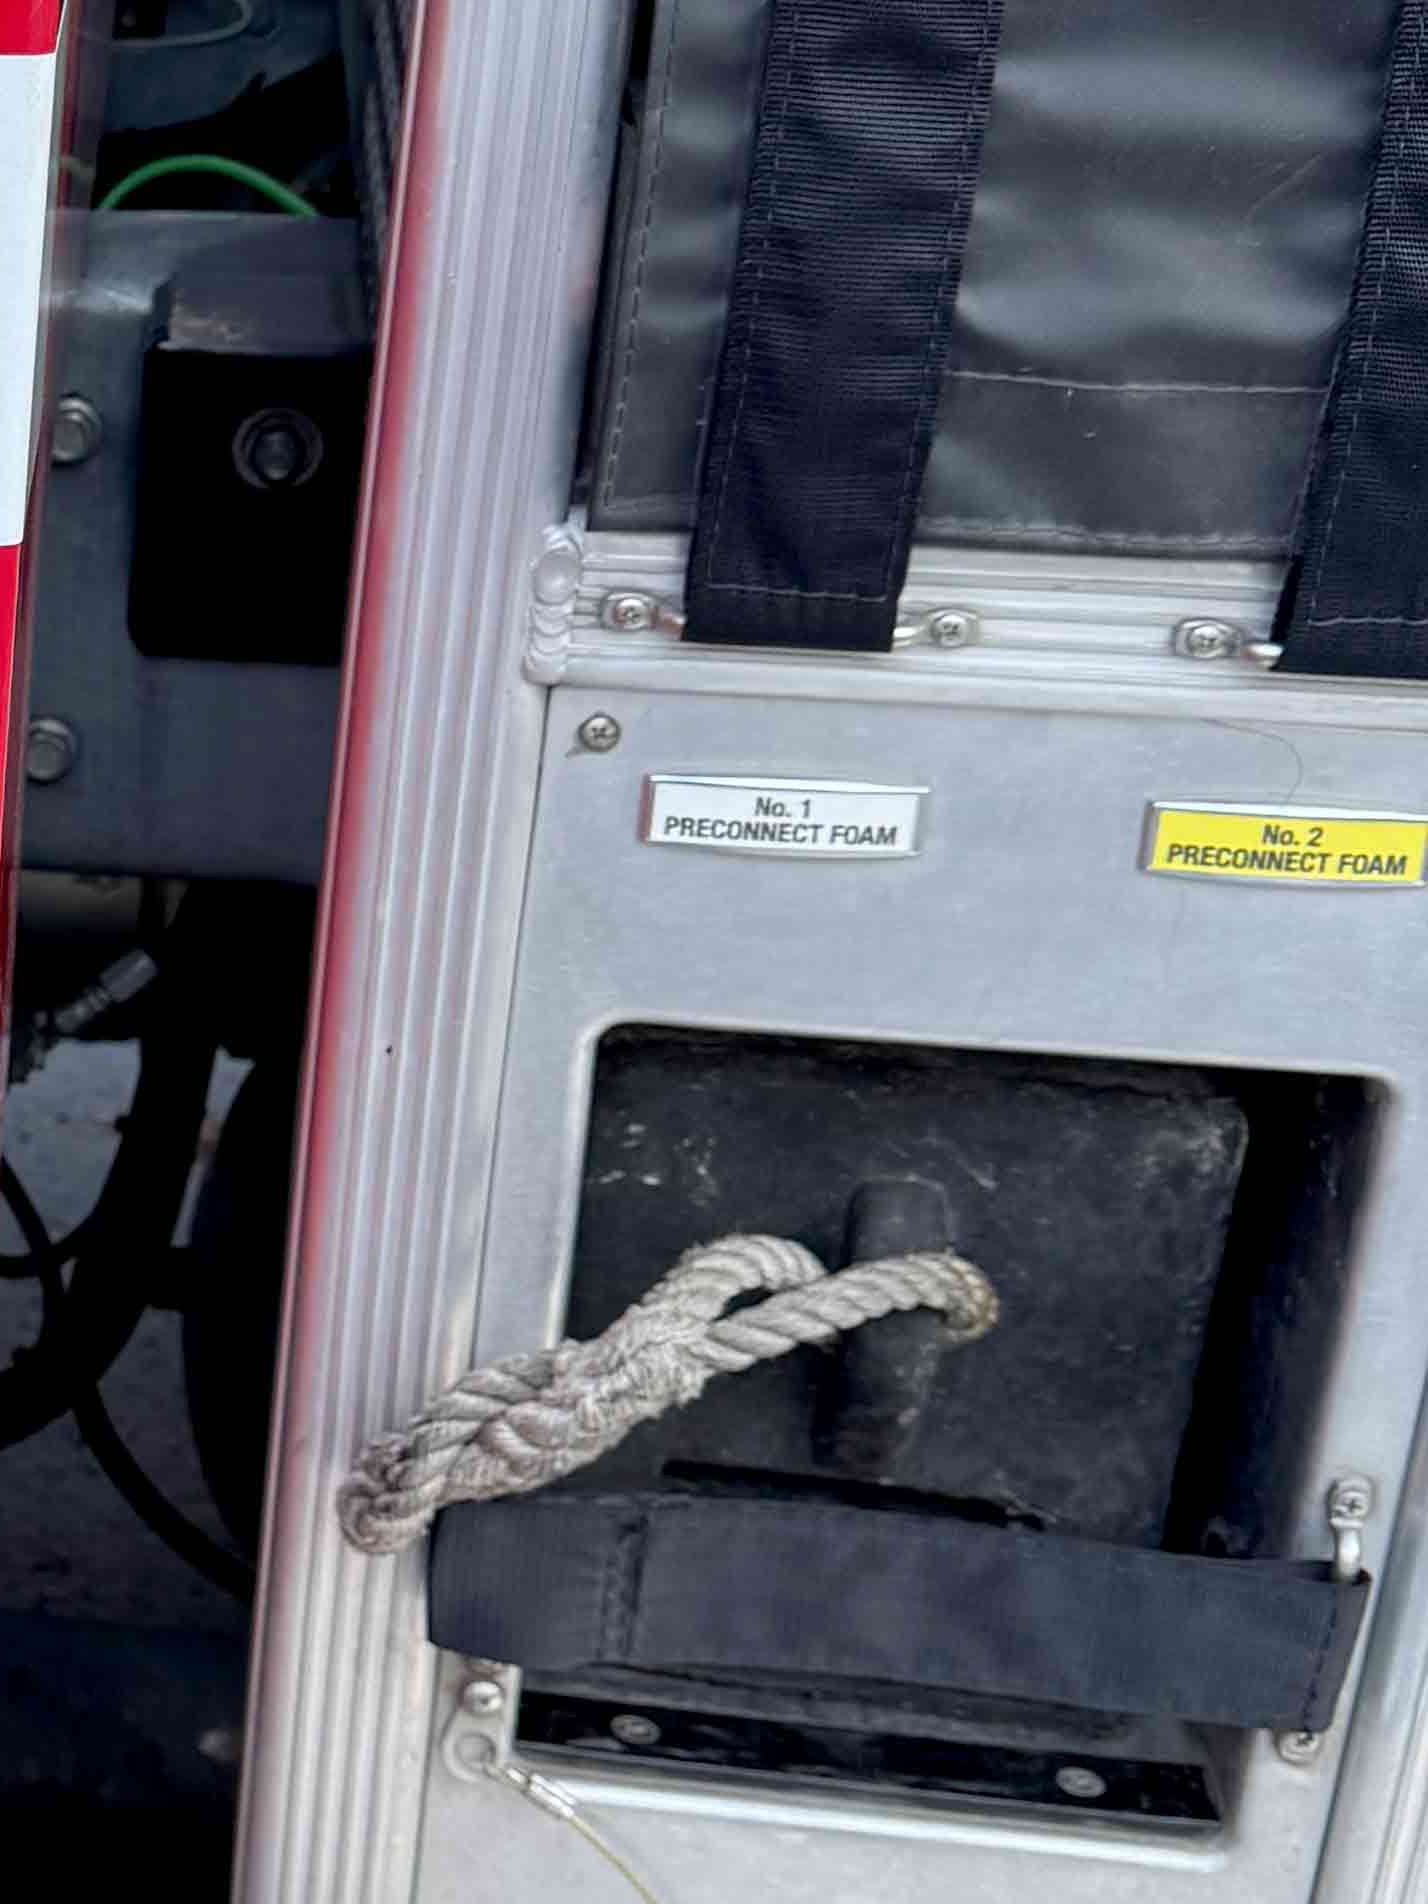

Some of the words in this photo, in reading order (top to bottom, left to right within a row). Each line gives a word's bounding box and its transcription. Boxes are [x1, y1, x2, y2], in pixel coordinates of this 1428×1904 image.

[754, 796, 791, 818] No.
[801, 799, 811, 819] 1
[663, 815, 823, 844] PRECONNECT
[828, 824, 898, 846] FOAM
[1261, 824, 1300, 846] No.
[1307, 827, 1324, 847] 2
[1166, 843, 1331, 873] PRECONNECT
[1337, 854, 1408, 876] FOAM
